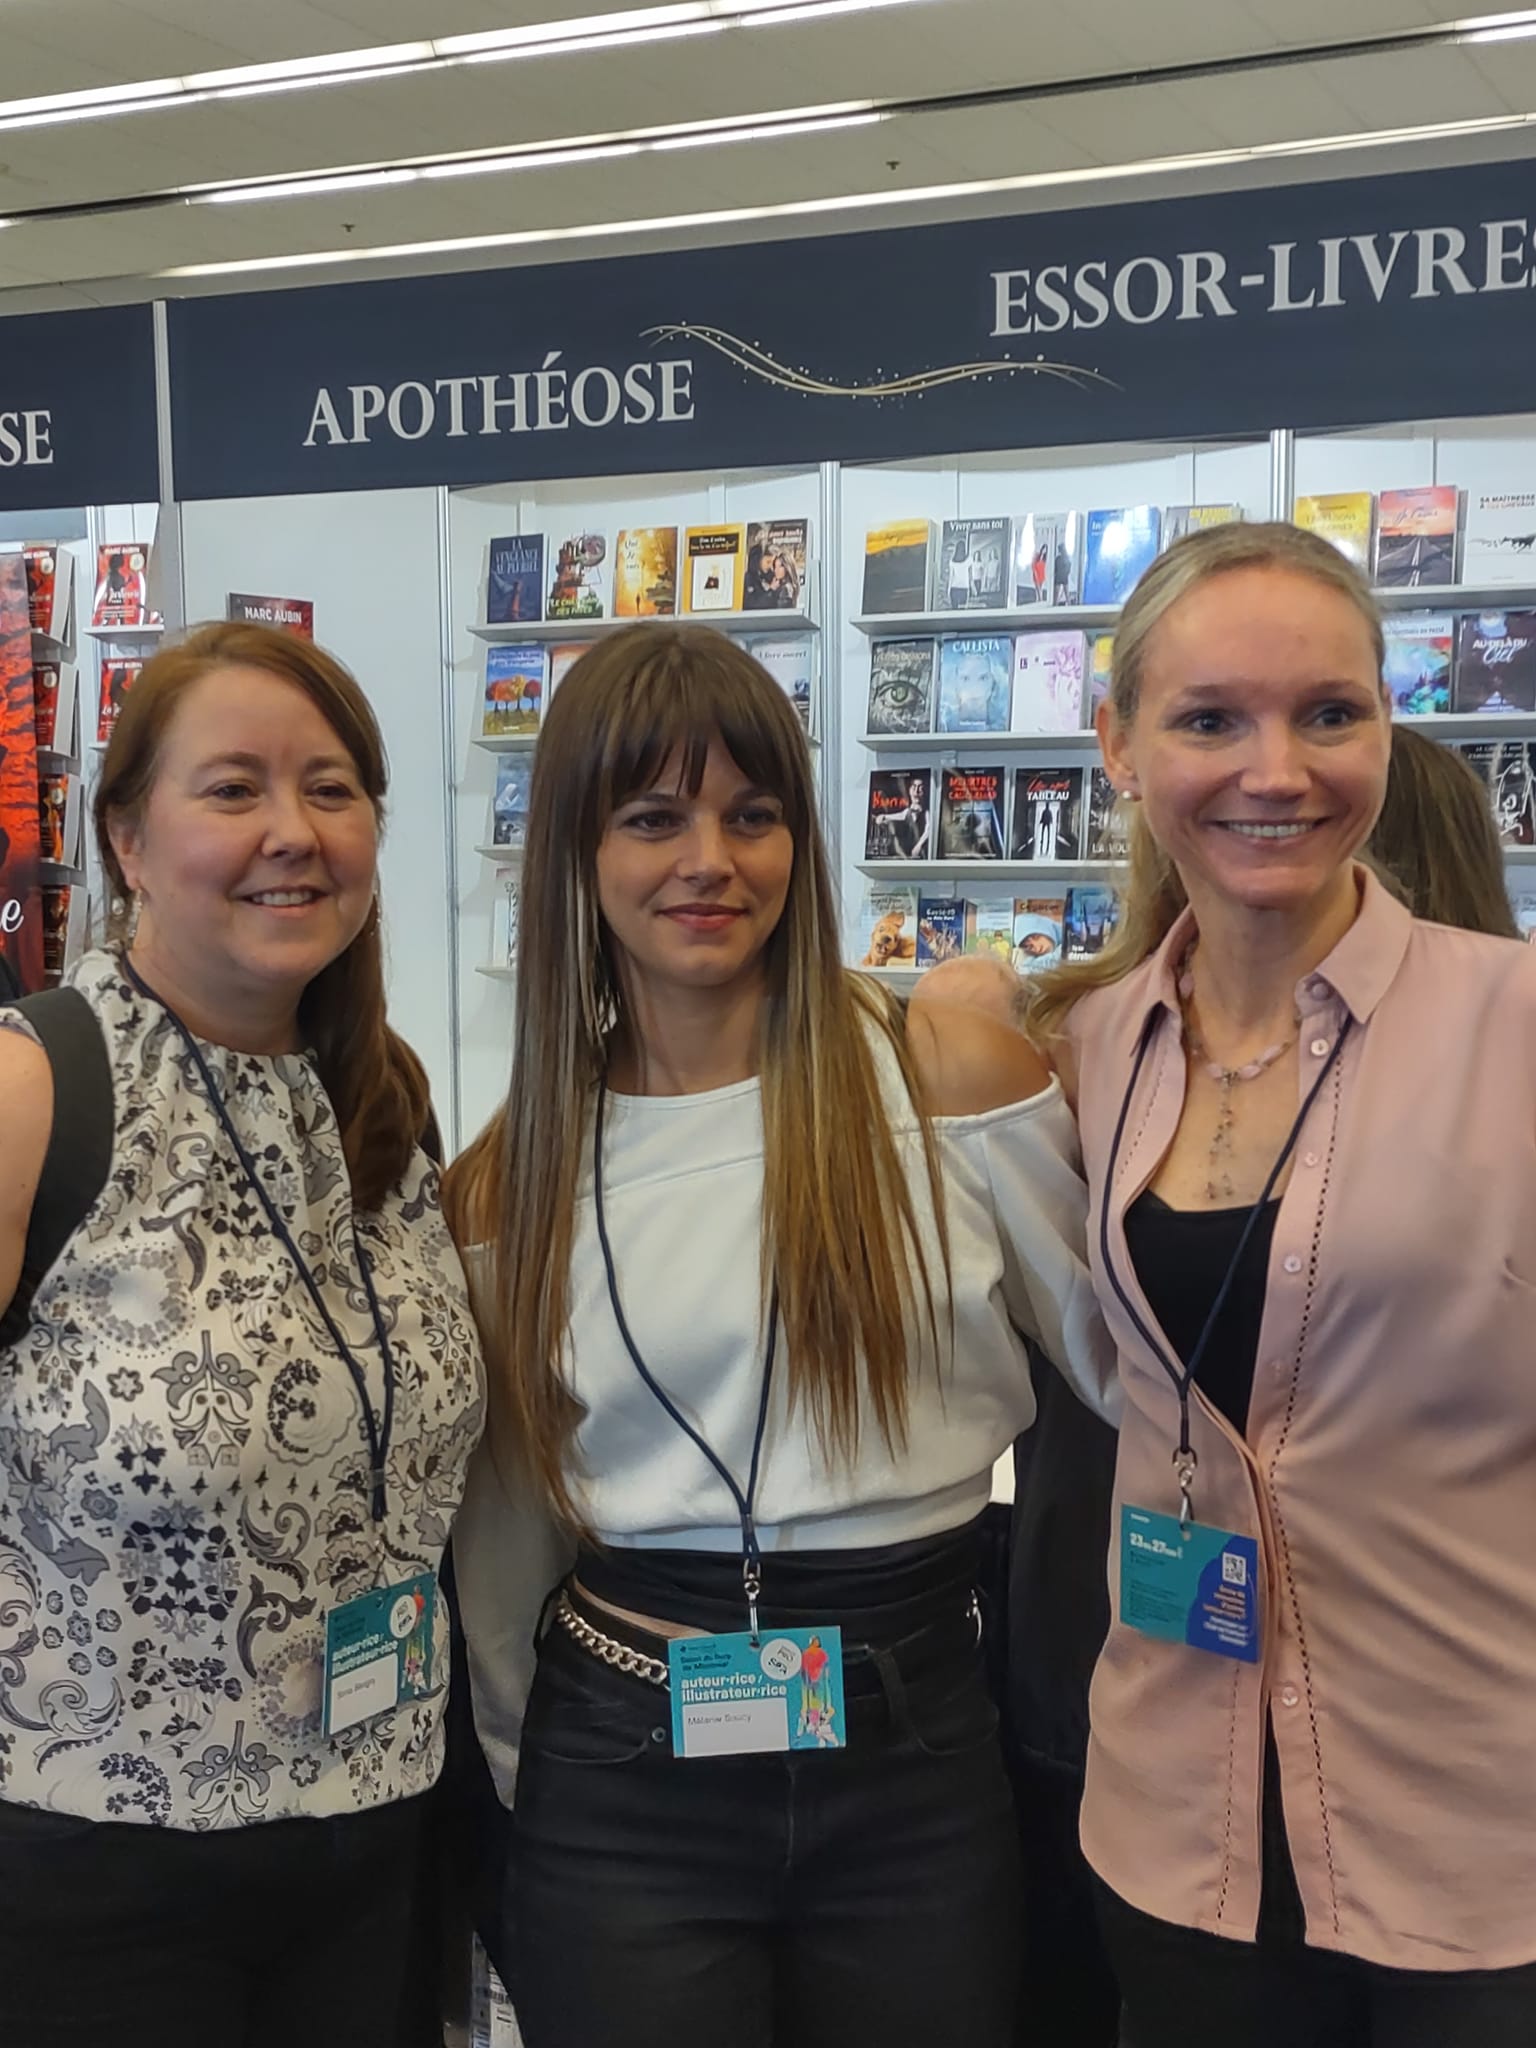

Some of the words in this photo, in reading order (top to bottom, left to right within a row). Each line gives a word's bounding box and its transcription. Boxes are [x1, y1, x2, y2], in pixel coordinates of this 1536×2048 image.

[990, 218, 1536, 337] ESSOR-LIVRE
[303, 351, 696, 447] APOTHÉOSE
[0, 409, 54, 466] SE
[950, 521, 971, 532] Vivre
[245, 606, 272, 621] MARC
[274, 609, 302, 624] AUBIN
[953, 640, 1000, 653] CALLISTA
[1027, 791, 1070, 801] TABLEAU
